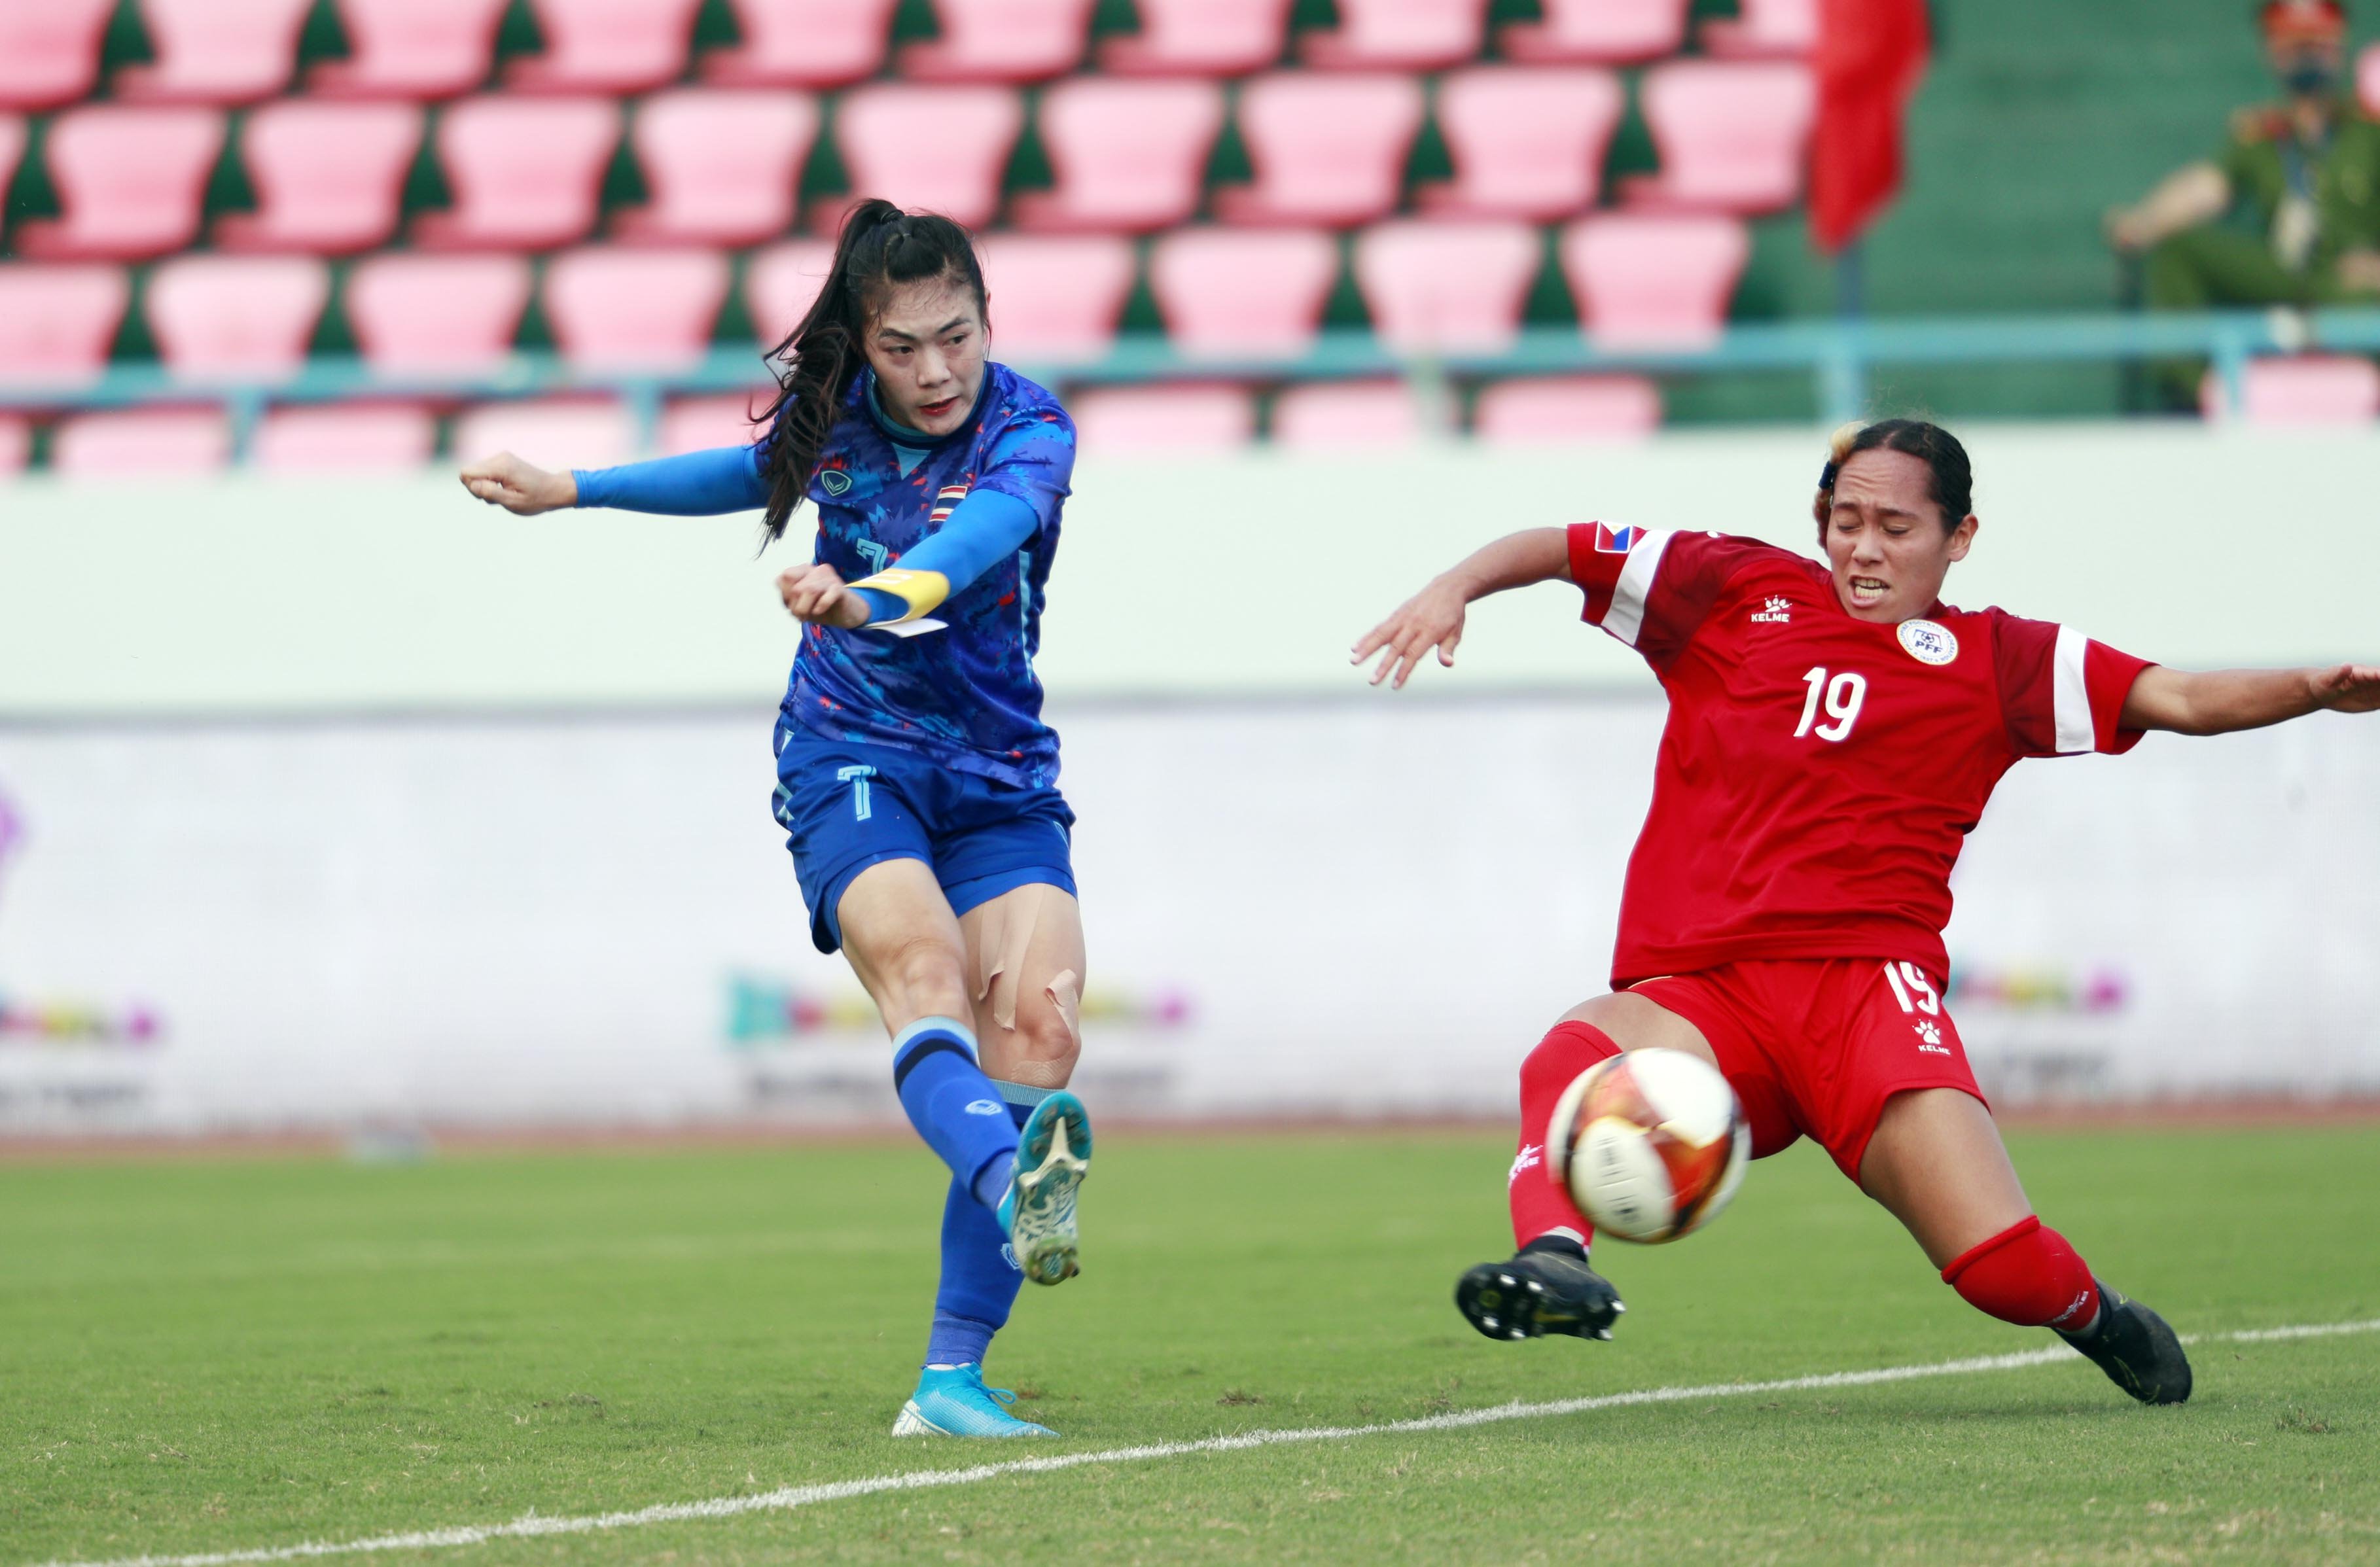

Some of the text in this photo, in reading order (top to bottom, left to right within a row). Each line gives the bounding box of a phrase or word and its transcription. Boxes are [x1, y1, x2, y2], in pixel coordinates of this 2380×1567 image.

[856, 537, 889, 575] 7
[1750, 612, 1790, 623] KELME
[1915, 640, 1943, 654] PFF
[1793, 666, 1867, 741] 19
[837, 765, 878, 822] 7
[1883, 960, 1939, 1015] 19
[1918, 1044, 1951, 1055] KELME
